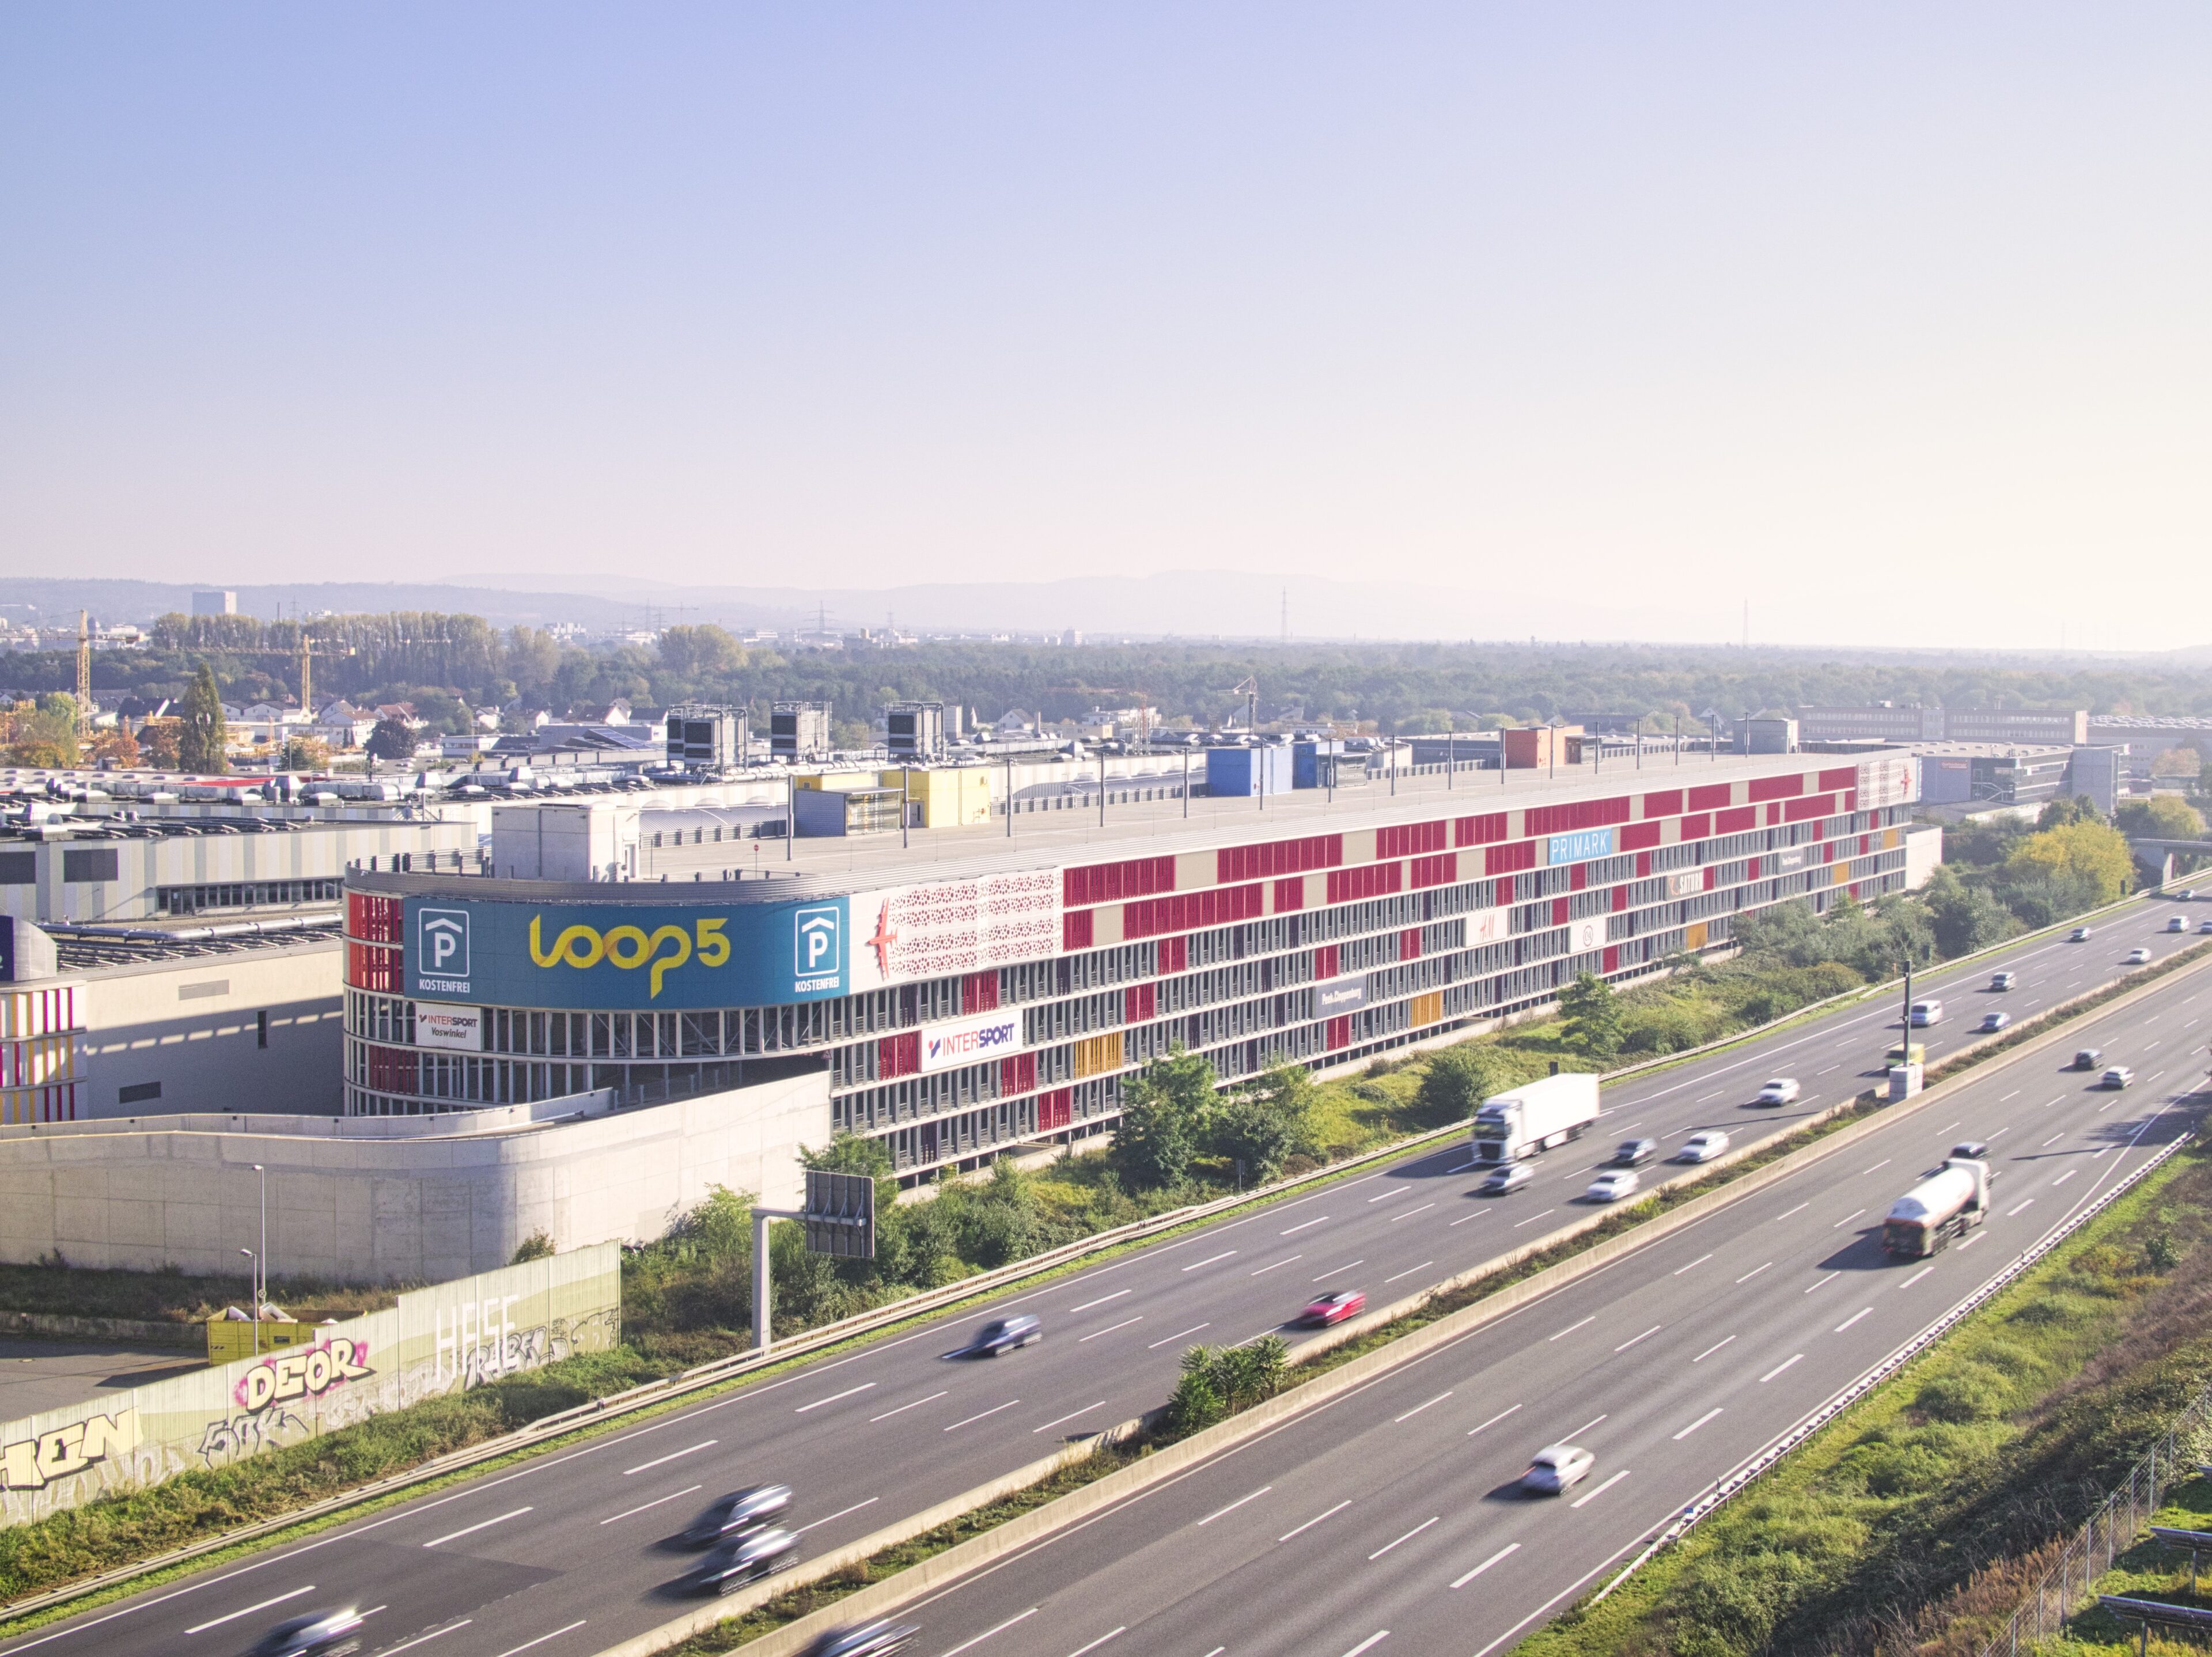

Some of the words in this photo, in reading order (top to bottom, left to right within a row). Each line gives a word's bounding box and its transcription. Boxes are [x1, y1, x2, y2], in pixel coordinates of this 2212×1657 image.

[1552, 832, 1607, 862] PRIMARK
[1680, 872, 1703, 894] SATURN
[435, 932, 456, 968] P
[809, 931, 828, 968] P
[419, 979, 470, 993] KOSTENFREI
[795, 976, 839, 992] KOSTENFREI
[428, 1015, 477, 1027] INTERSPORT
[431, 1027, 467, 1038] Voswinkel
[943, 1023, 1014, 1056] INTERSPORT
